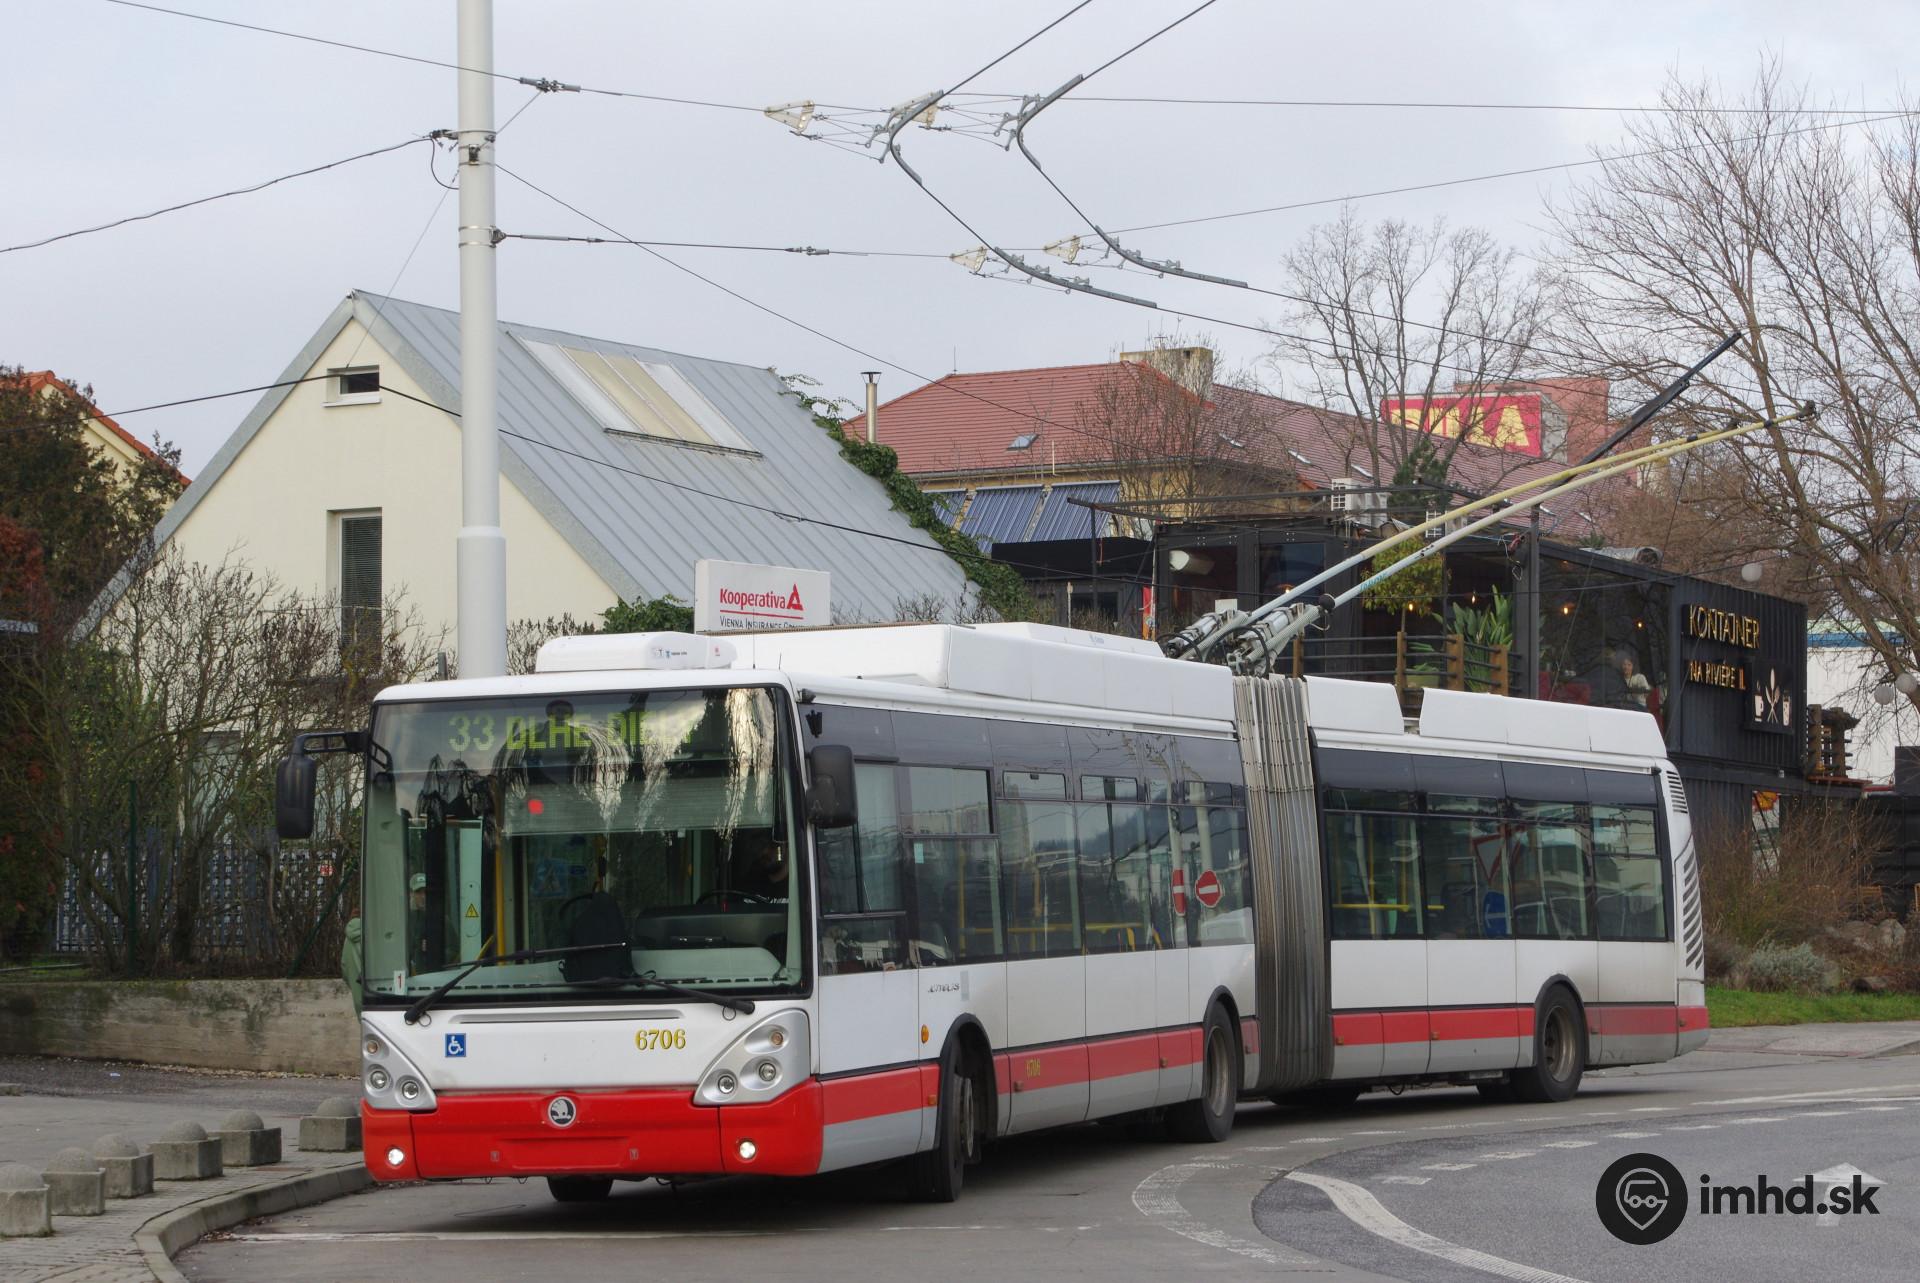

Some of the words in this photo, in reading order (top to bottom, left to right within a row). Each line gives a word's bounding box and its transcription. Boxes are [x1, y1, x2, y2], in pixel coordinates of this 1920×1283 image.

[719, 588, 786, 610] Kooperativa
[719, 615, 744, 630] VIENNA
[1689, 604, 1760, 649] KONTAJNER
[1690, 661, 1703, 684] NA
[449, 714, 496, 751] 33
[506, 714, 592, 749] DLHE
[634, 1029, 687, 1051] 6706
